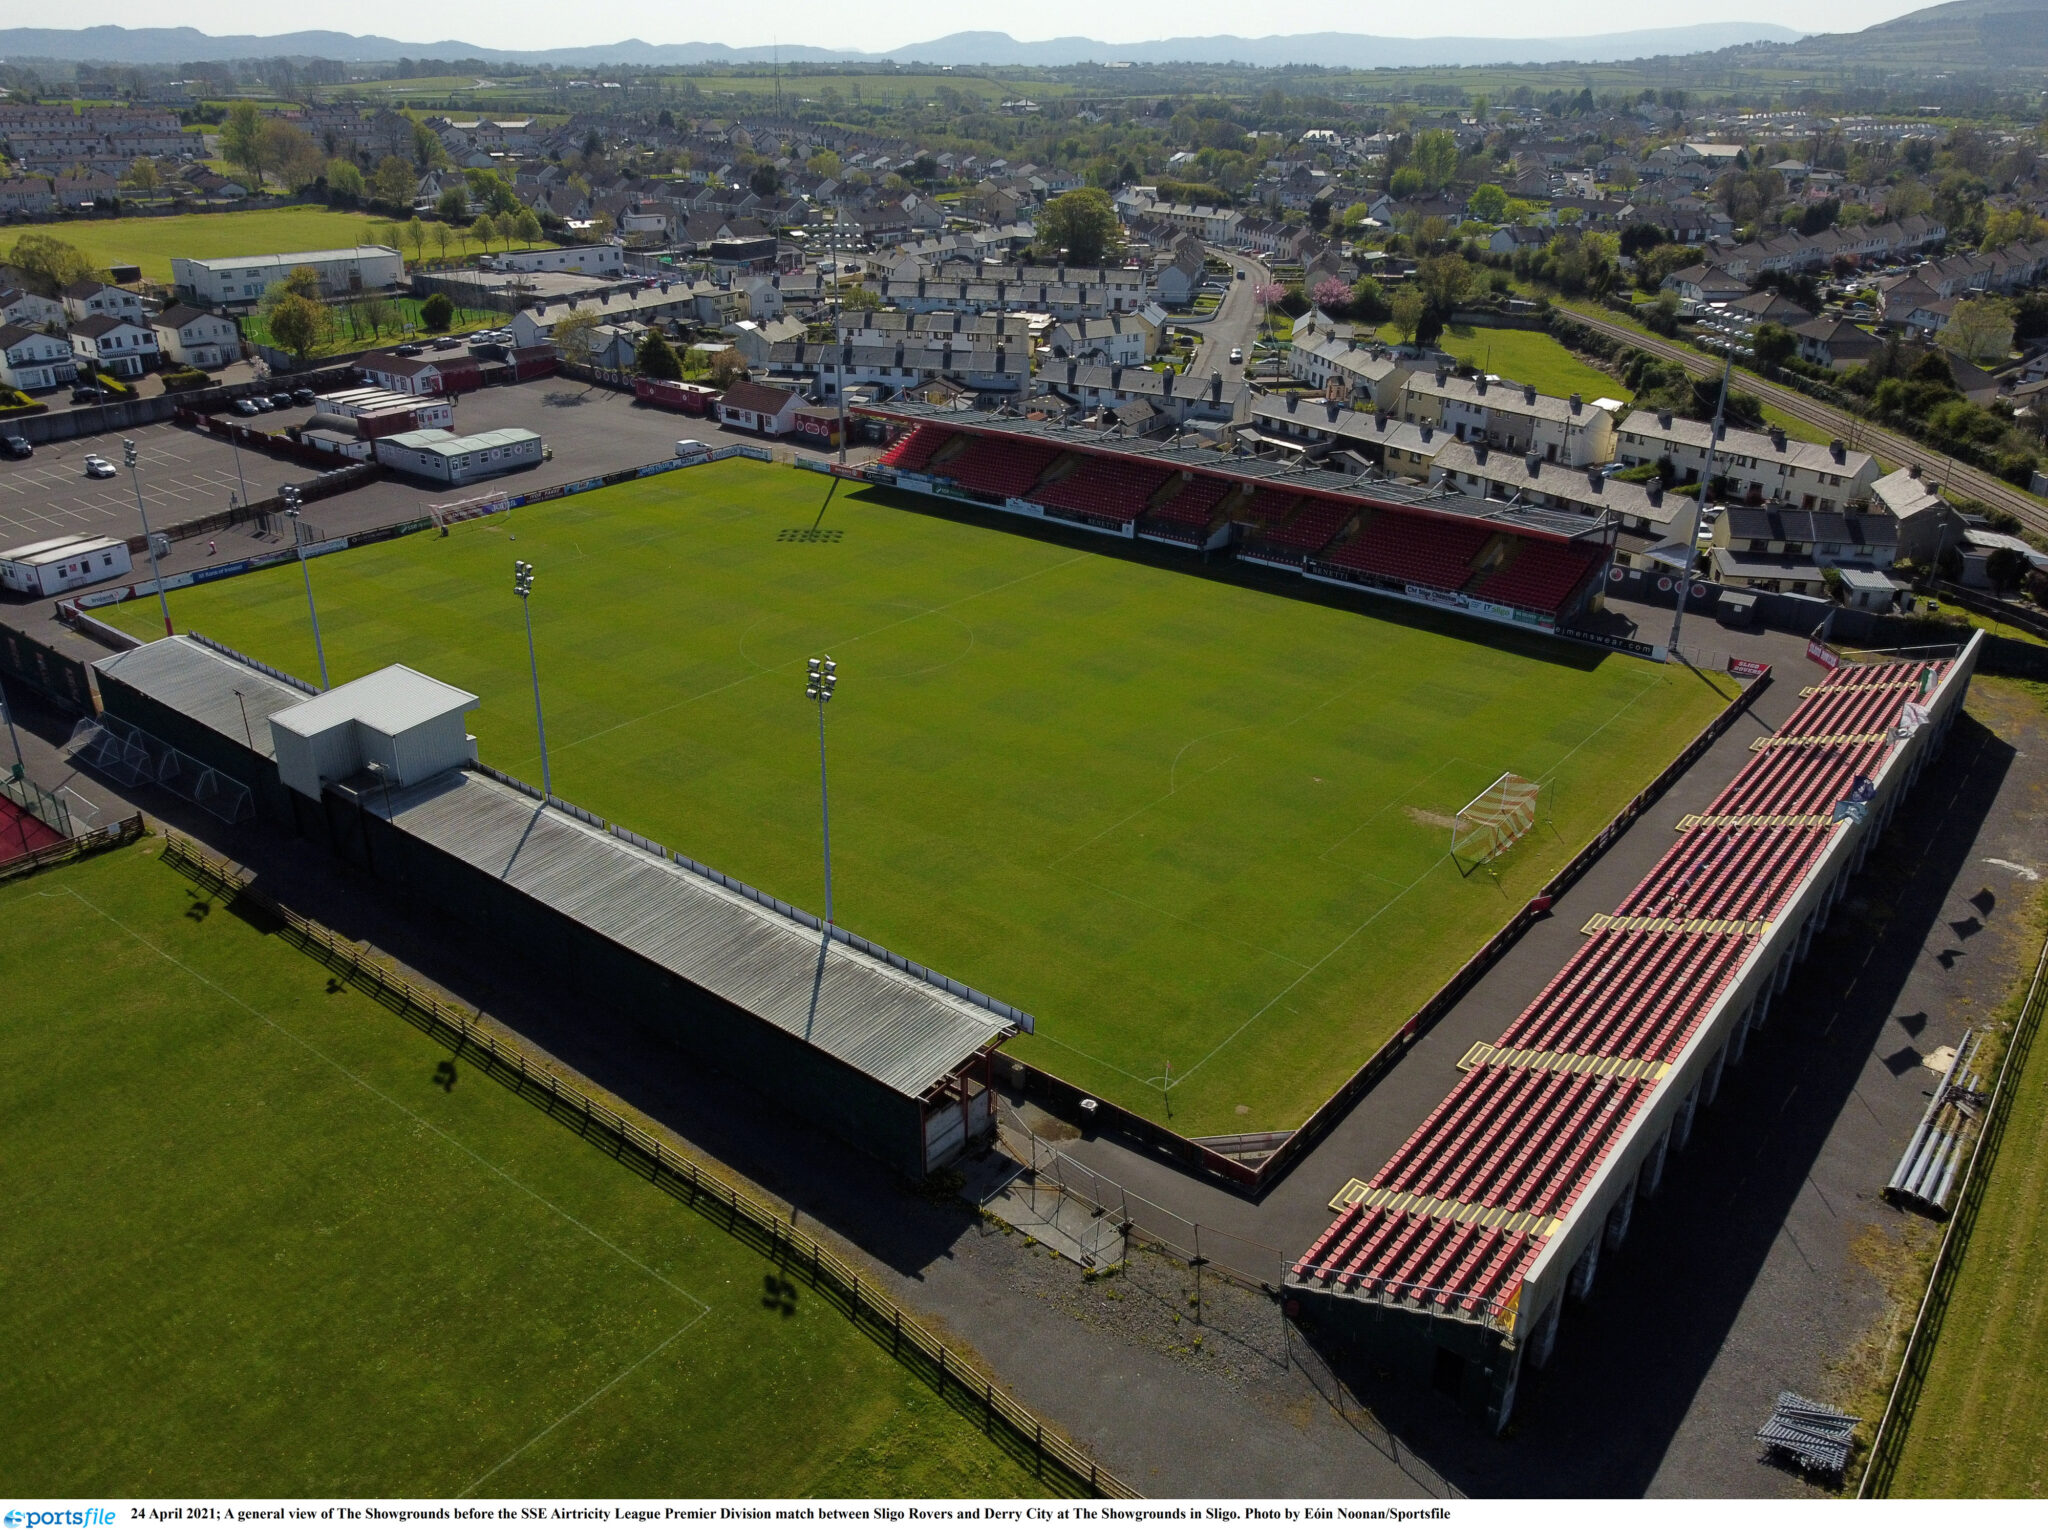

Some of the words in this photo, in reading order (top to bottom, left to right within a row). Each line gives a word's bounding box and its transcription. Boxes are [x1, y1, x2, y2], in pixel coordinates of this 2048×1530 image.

[1312, 567, 1349, 581] BENETTI
[1555, 625, 1651, 653] ejmenswear.com
[1733, 666, 1762, 675] ROVERS
[1738, 661, 1760, 669] SLIGO
